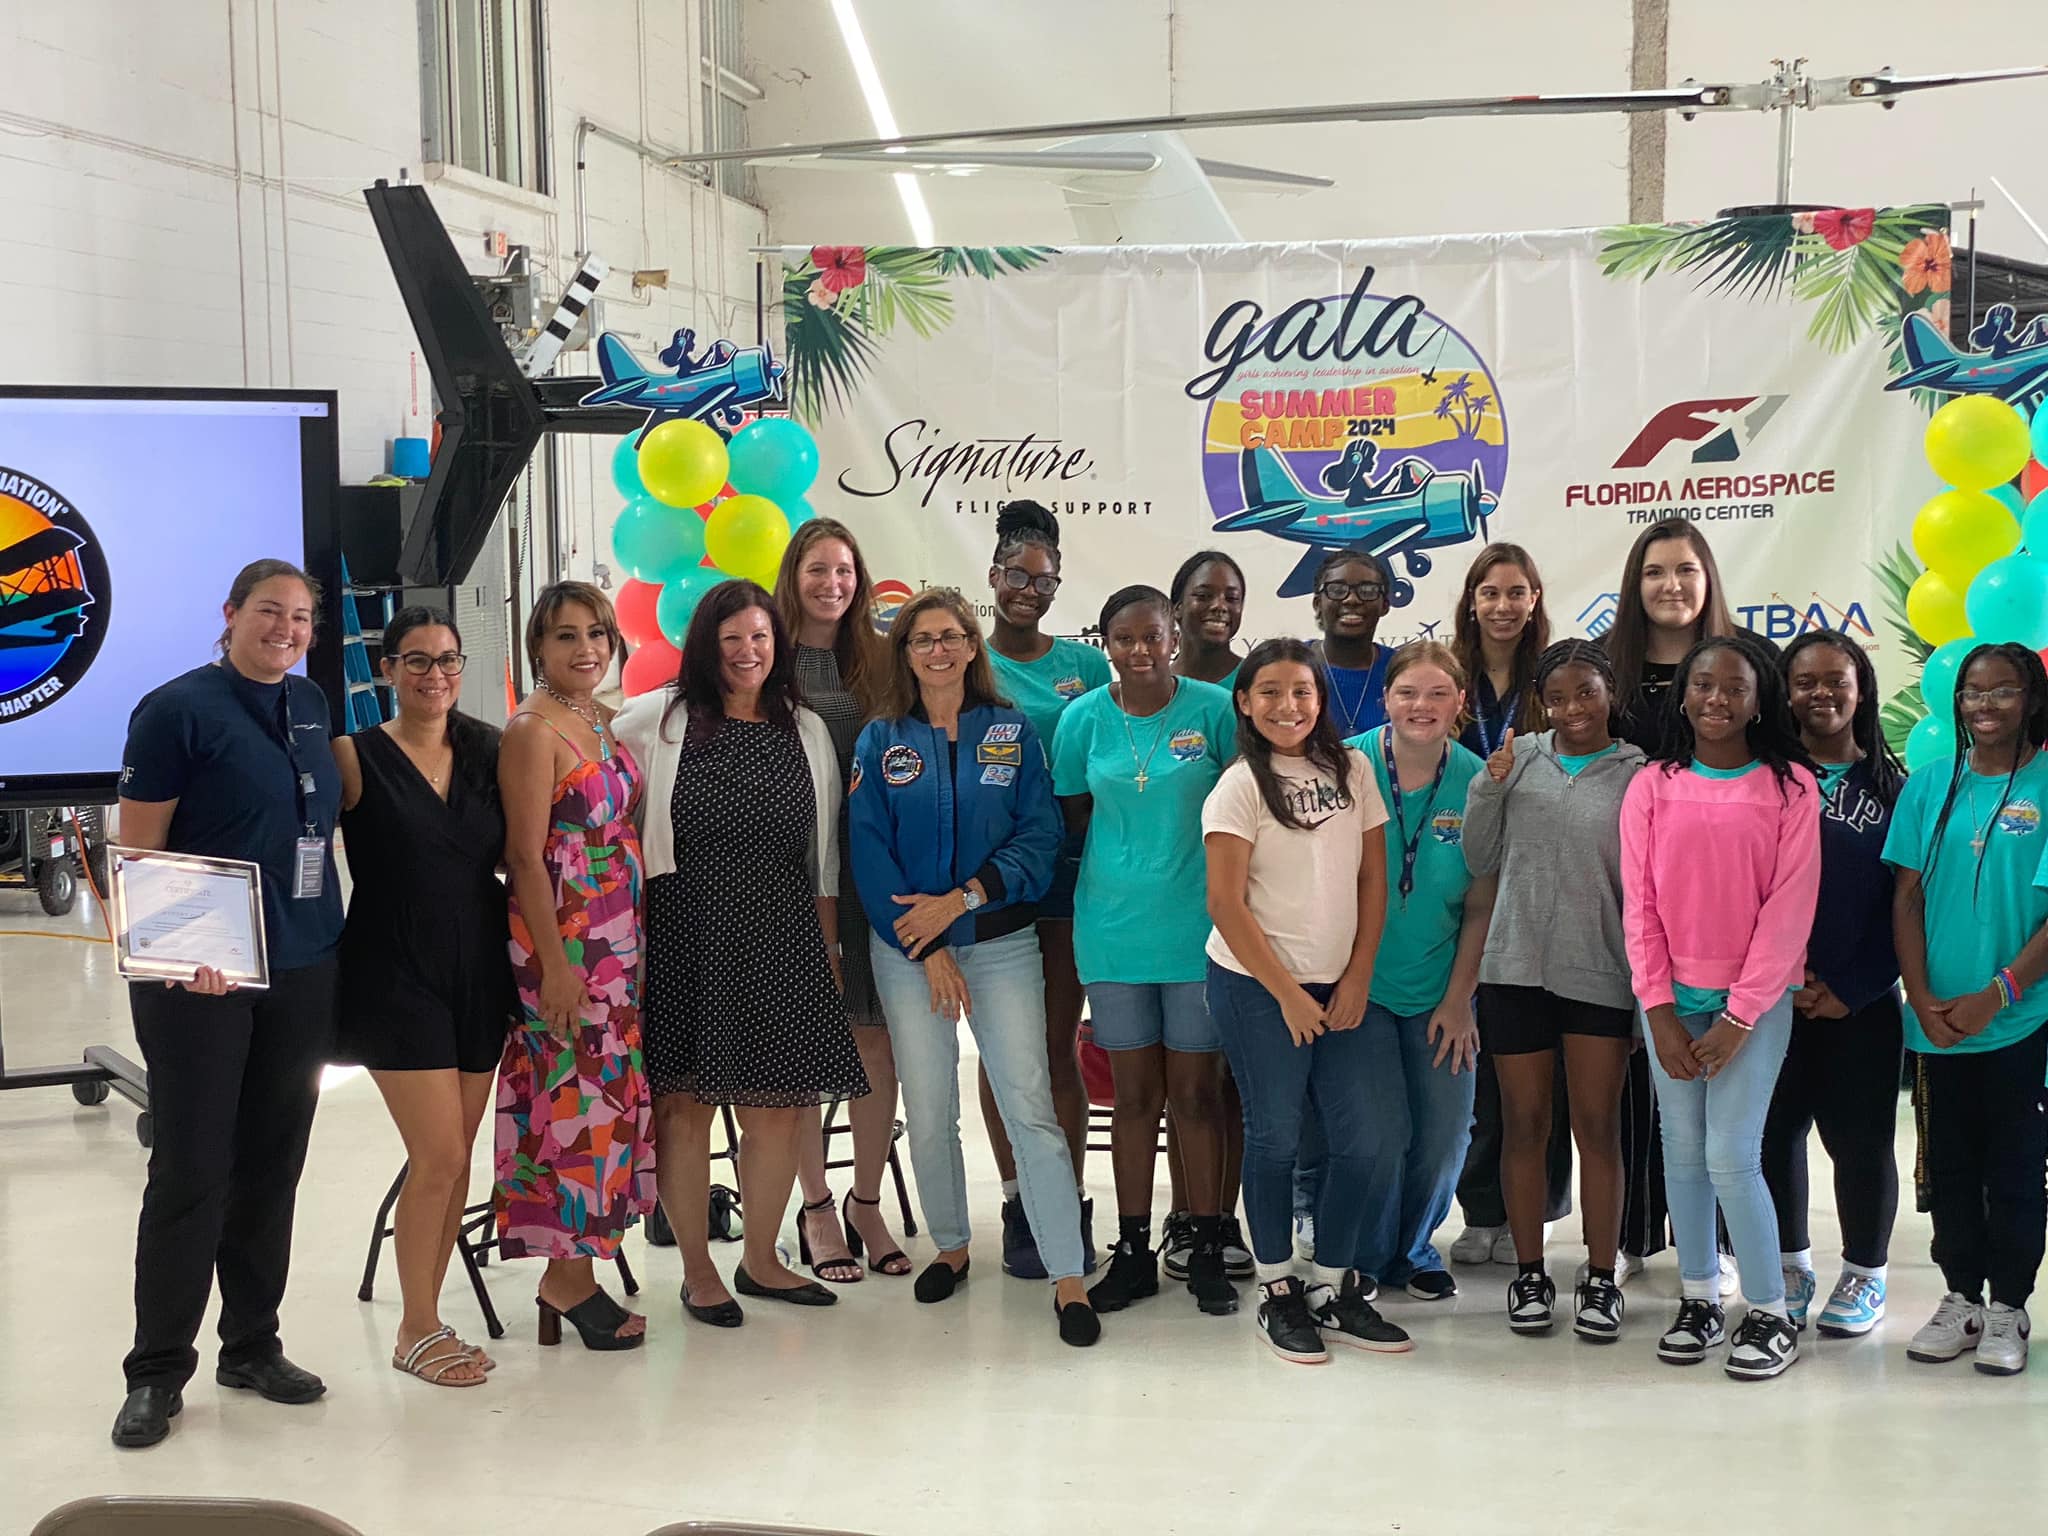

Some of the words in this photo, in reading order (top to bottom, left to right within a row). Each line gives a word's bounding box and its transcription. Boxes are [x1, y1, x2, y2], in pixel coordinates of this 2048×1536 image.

[1185, 265, 1447, 400] gala
[1236, 368, 1260, 381] girls
[1262, 366, 1309, 380] achieving
[1312, 365, 1362, 378] leadership
[1365, 365, 1376, 375] in
[1378, 365, 1421, 376] aviation
[1240, 386, 1397, 420] SUMMER
[1240, 418, 1345, 449] CAMP
[1346, 417, 1396, 437] 2024
[838, 418, 1095, 508] Signature
[0, 471, 63, 518] IATION
[1565, 479, 1673, 507] FLORIDA
[1680, 469, 1835, 501] AEROSPACE
[956, 500, 1006, 514] FLIG
[1051, 501, 1153, 515] SUPPORT
[1626, 507, 1701, 524] TRAINING
[1705, 503, 1774, 520] CENTER
[1736, 602, 1874, 639] TBAA
[0, 676, 64, 716] HAPTER
